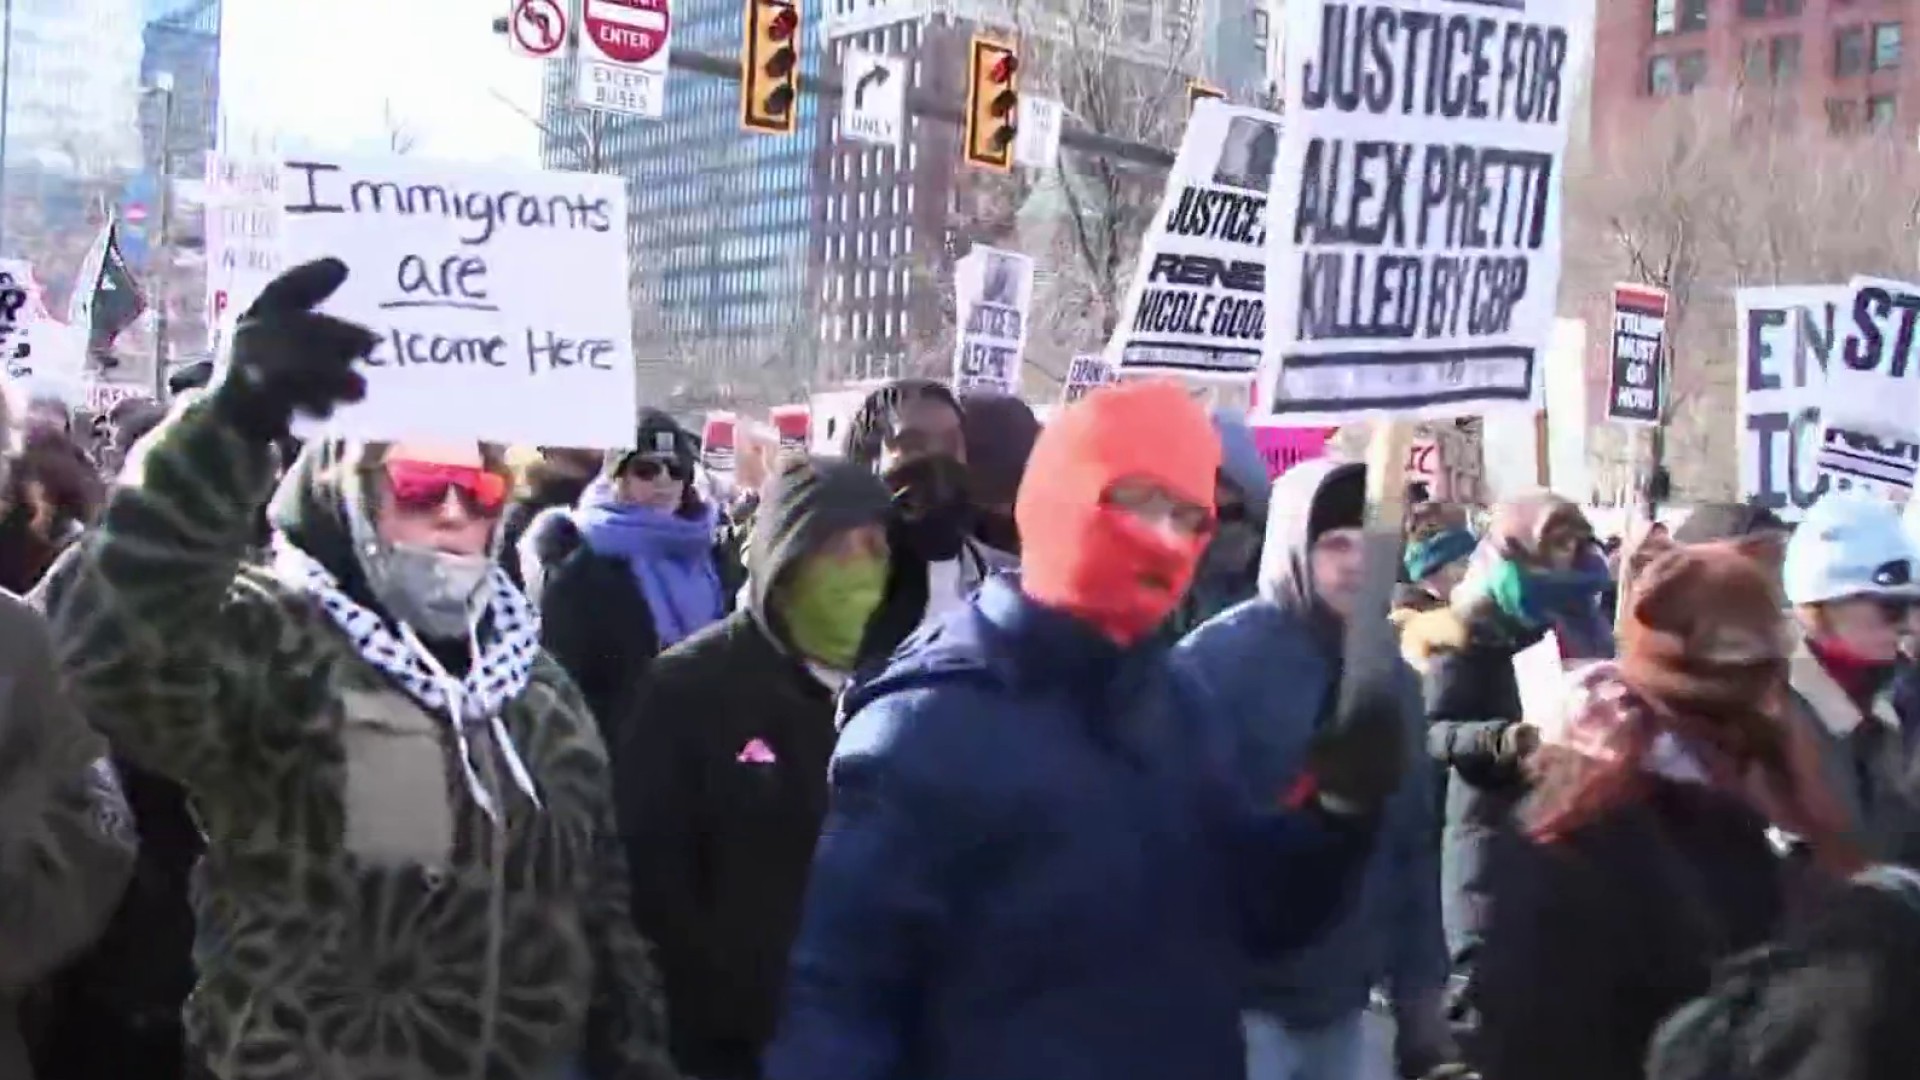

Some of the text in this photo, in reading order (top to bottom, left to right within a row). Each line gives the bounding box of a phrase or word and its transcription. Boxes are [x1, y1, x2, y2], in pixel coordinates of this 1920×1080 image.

[600, 24, 651, 49] ENTER
[594, 66, 650, 90] EXCEPT
[1301, 4, 1567, 121] JUSTICE FOR
[595, 86, 648, 110] BUSES
[851, 116, 892, 135] ONLY
[284, 161, 611, 244] Immigrants
[1166, 186, 1264, 246] JUSTICE
[1294, 137, 1412, 248] ALEX
[1416, 143, 1553, 250] PRETTI
[397, 254, 488, 298] are
[1149, 253, 1266, 292] RENE
[1297, 252, 1529, 341] KILLED BY CBP
[1133, 288, 1217, 336] NICOLE
[363, 326, 616, 375] elcome Here
[1617, 336, 1657, 364] MUST
[1747, 301, 1836, 391] EN
[1626, 363, 1647, 385] GO
[1746, 407, 1829, 508] IC
